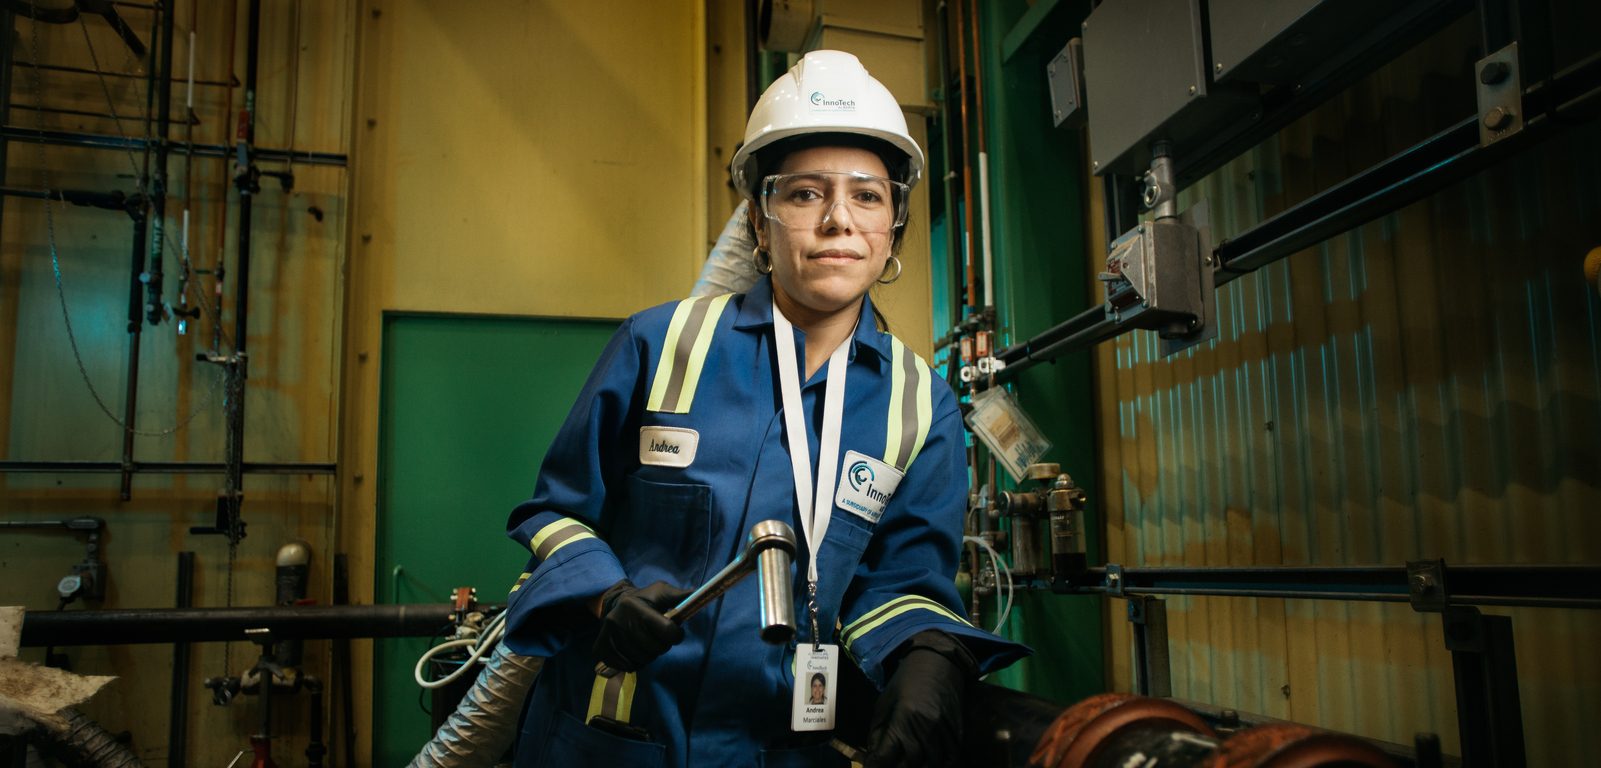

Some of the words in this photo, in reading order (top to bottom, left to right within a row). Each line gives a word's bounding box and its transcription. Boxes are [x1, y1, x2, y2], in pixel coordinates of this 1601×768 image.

[648, 438, 681, 455] Andrea
[805, 706, 825, 714] Andrea
[802, 716, 827, 724] Marciales
